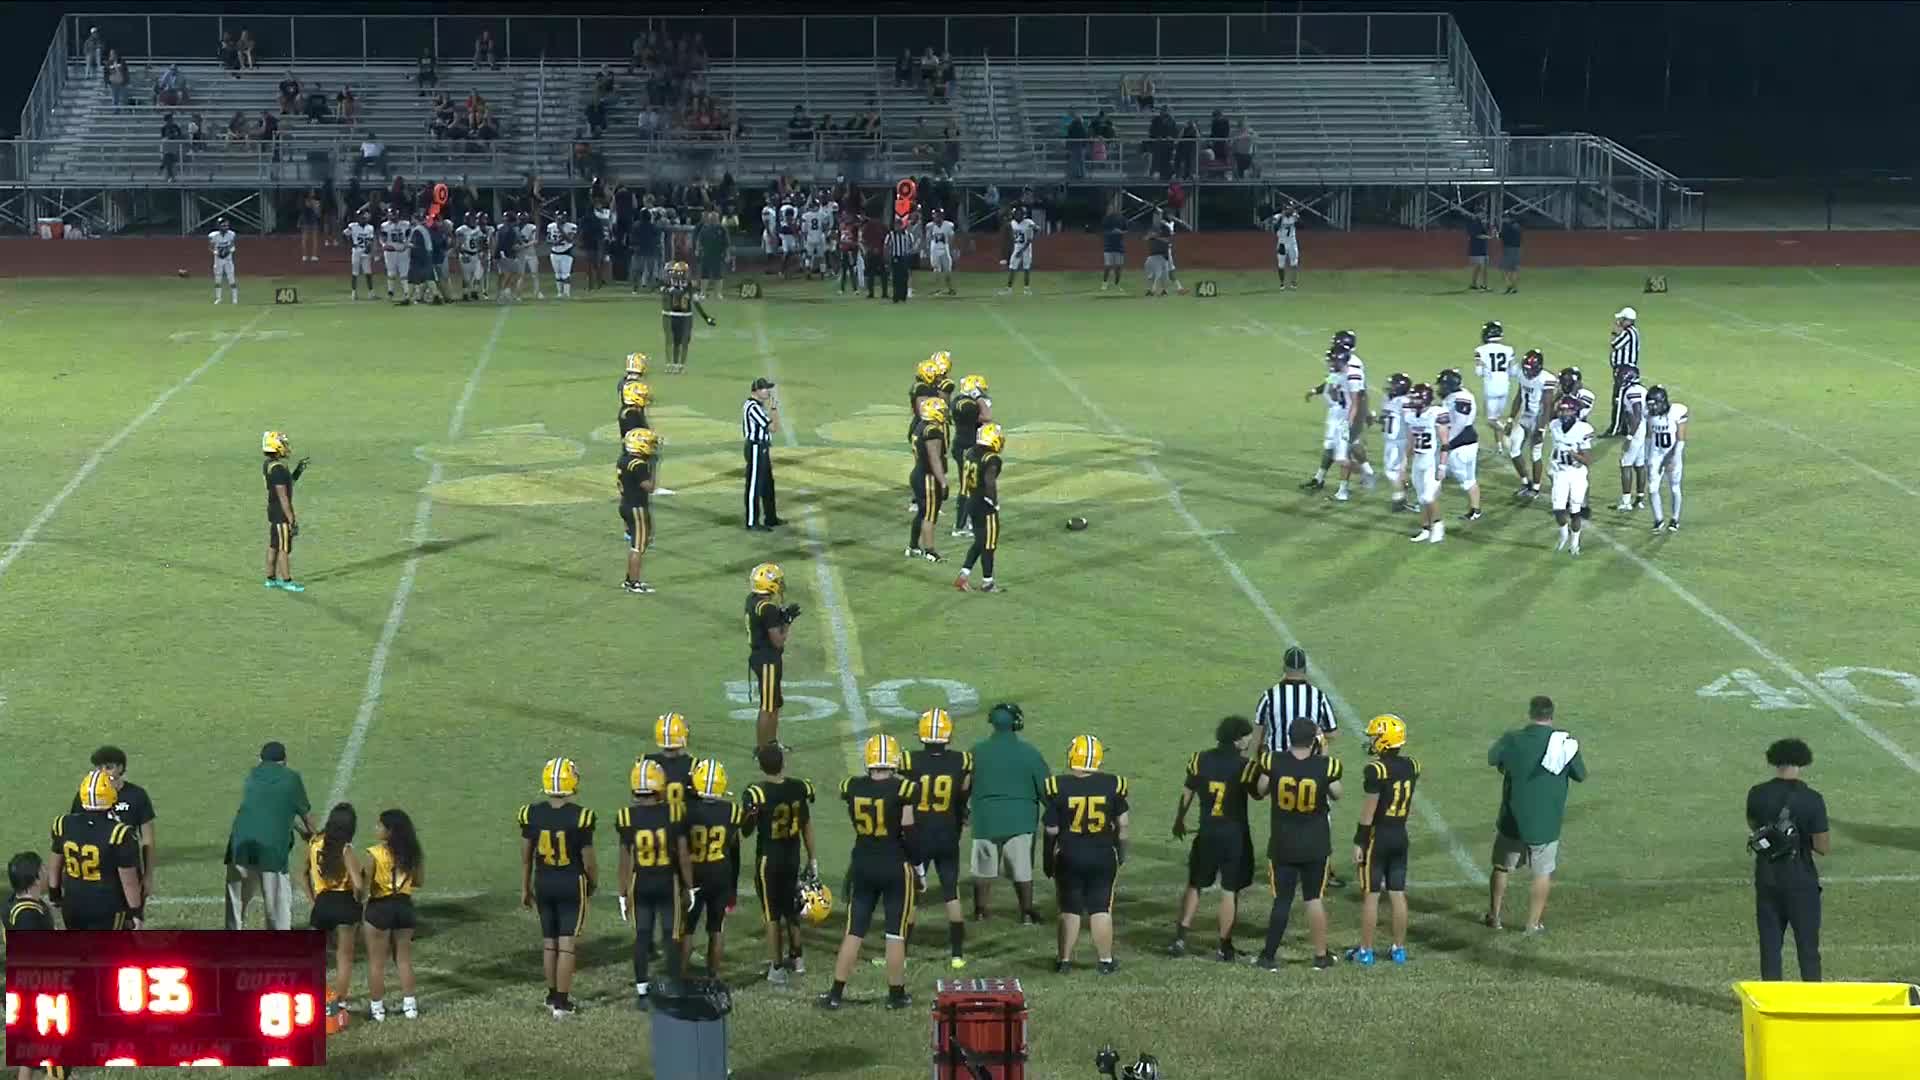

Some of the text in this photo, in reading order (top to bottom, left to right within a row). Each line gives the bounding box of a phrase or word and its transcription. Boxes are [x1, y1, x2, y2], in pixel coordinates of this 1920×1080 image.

[811, 217, 819, 231] 8
[277, 291, 295, 304] 40
[1199, 282, 1215, 296] 40
[1489, 351, 1506, 372] 12
[1655, 432, 1672, 449] 10
[1695, 666, 1920, 710] 40
[918, 775, 953, 812] 19
[1209, 782, 1226, 816] 7
[1278, 776, 1318, 813] 60
[1386, 781, 1411, 817] 11
[854, 797, 888, 837] 51
[1068, 795, 1107, 833] 75
[63, 840, 102, 881] 62
[538, 830, 570, 867] 41
[635, 828, 671, 866] 81
